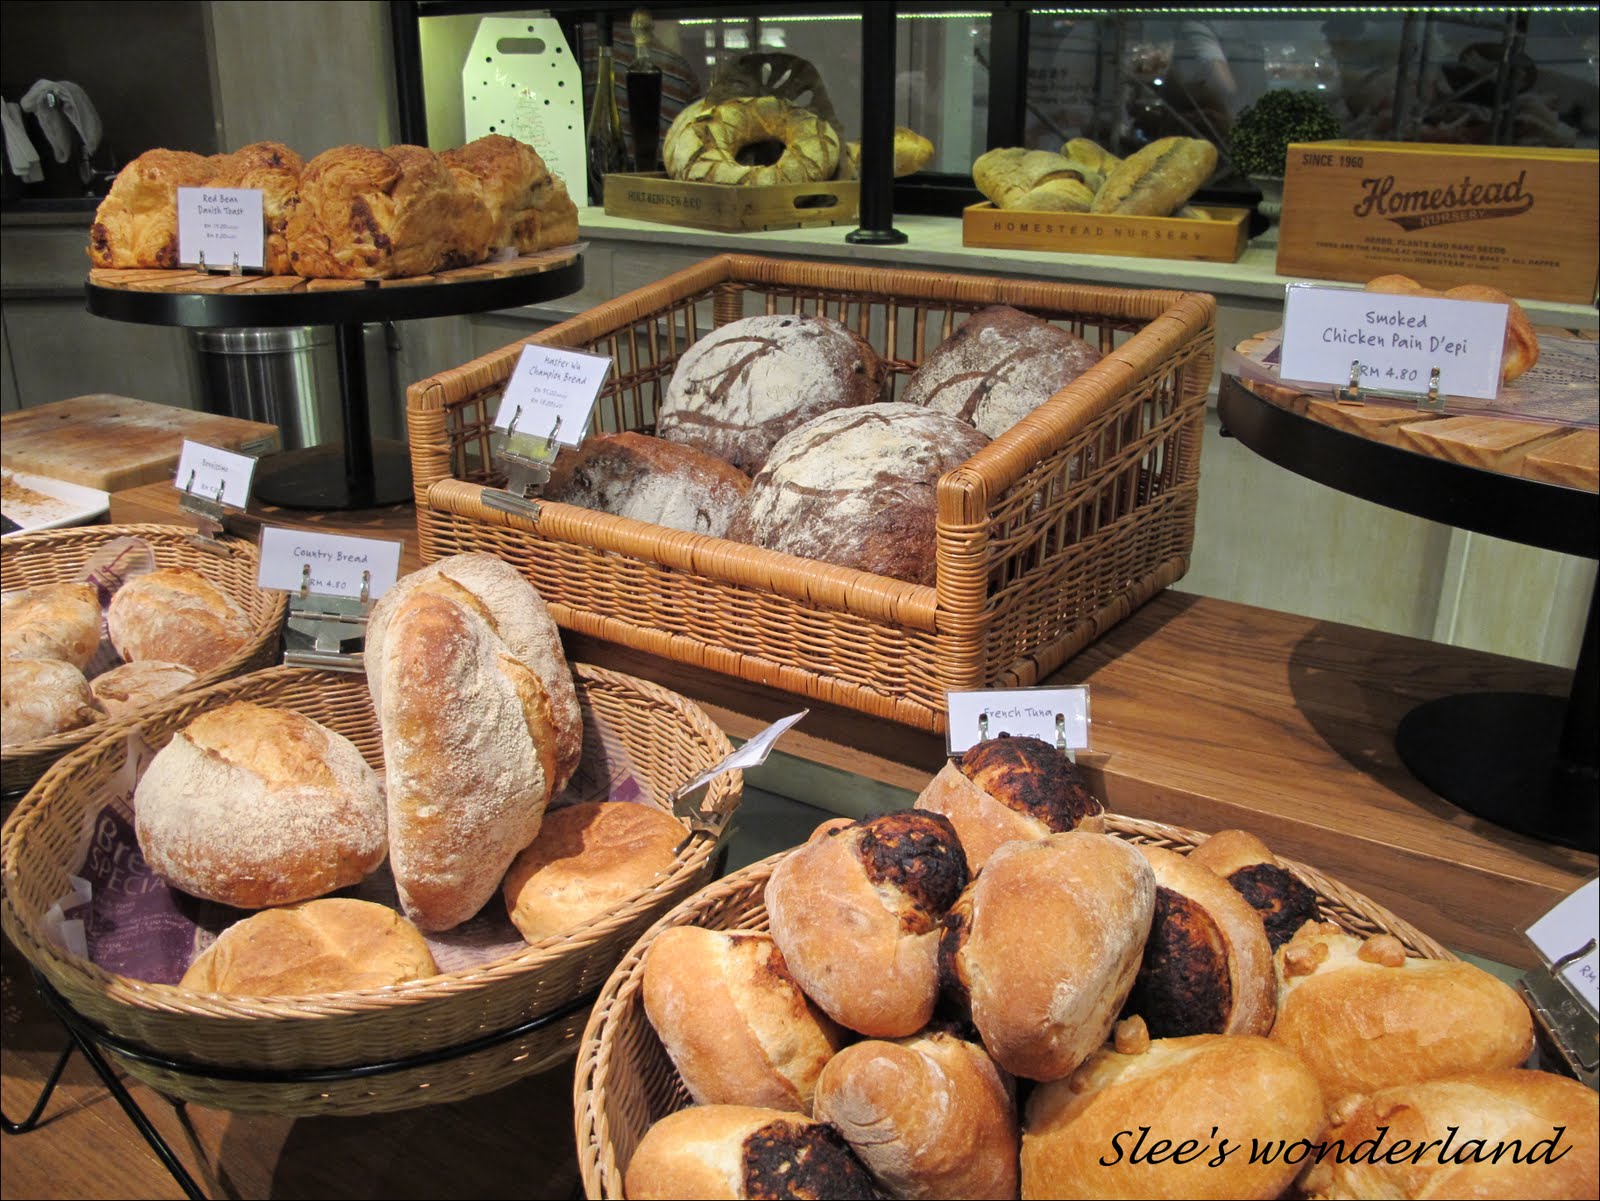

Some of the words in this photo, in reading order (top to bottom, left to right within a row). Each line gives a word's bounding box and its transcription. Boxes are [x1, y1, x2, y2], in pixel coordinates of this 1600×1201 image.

[1302, 153, 1333, 167] SINCE
[1340, 155, 1364, 168] 1960
[203, 194, 217, 203] Red
[1353, 170, 1534, 218] Homestead
[197, 205, 222, 215] Danish
[224, 207, 244, 216] Toast
[1420, 210, 1486, 226] NURSERY
[994, 222, 1104, 237] HOMESTEAD
[1114, 228, 1202, 241] NURSERY
[1365, 310, 1428, 328] Smoked
[1322, 327, 1385, 348] Chicken
[1392, 334, 1422, 351] Pain
[1430, 336, 1468, 356] D'epi
[529, 366, 561, 380] Champion
[563, 373, 587, 384] Bread
[1360, 364, 1380, 378] RM
[1385, 367, 1418, 381] 4.80
[293, 546, 333, 562] Country
[337, 551, 368, 563] Bread
[310, 578, 323, 587] RM
[326, 580, 347, 590] 4.80
[984, 706, 1021, 718] French
[1025, 707, 1053, 718] Tuna
[97, 815, 148, 877] Bre
[89, 847, 166, 896] SPECIA
[1579, 964, 1597, 984] RM
